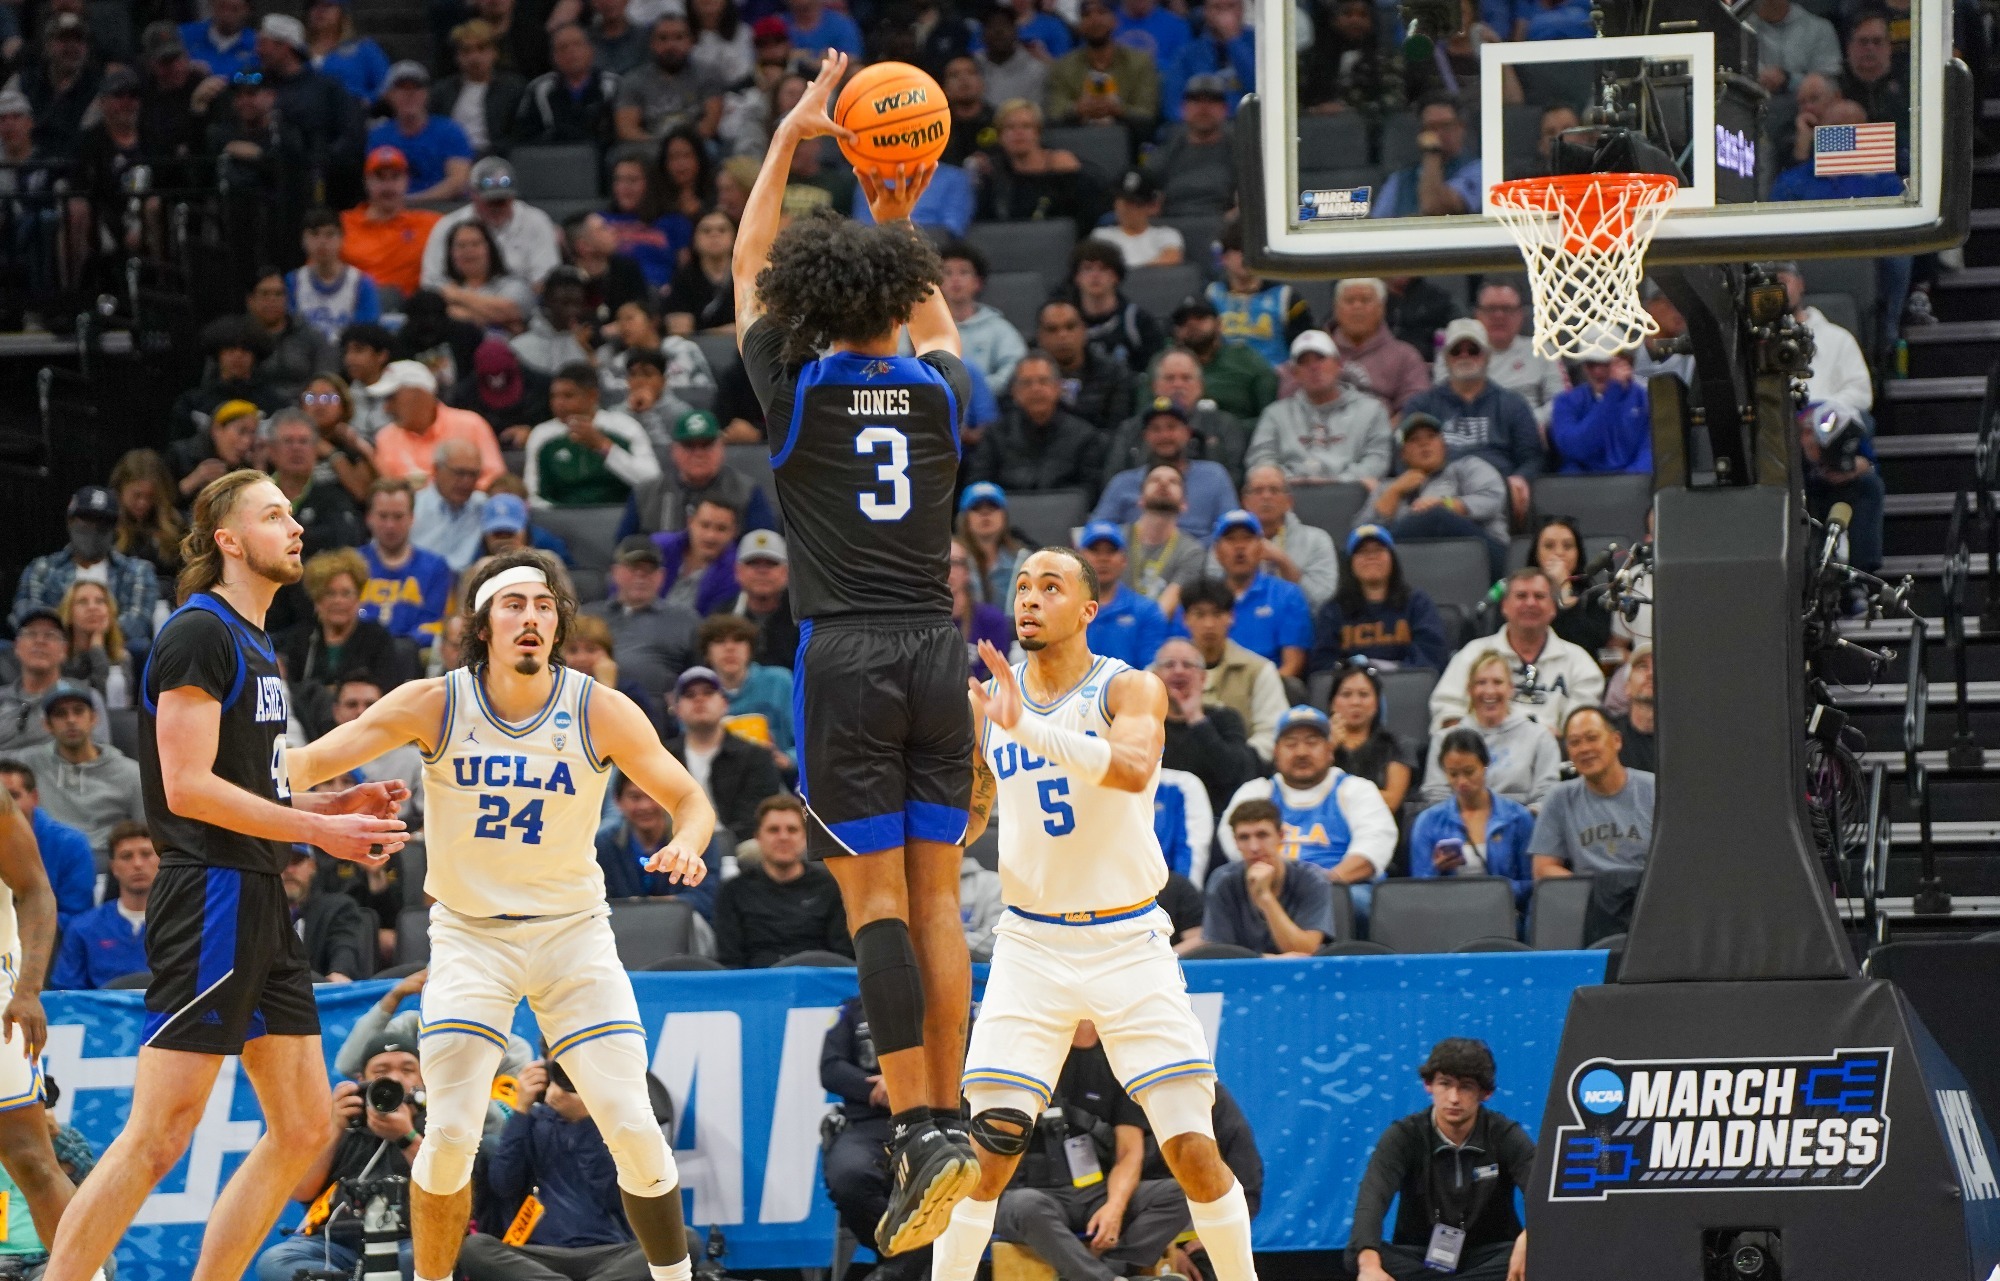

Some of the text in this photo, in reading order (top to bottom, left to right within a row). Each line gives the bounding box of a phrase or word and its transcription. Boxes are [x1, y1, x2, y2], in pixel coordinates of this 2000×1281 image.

[872, 87, 927, 115] NCAA
[872, 119, 945, 148] Wilson
[848, 389, 910, 415] JONES
[855, 426, 911, 521] 3
[453, 755, 576, 796] UCLA
[474, 793, 544, 845] 24
[1037, 777, 1076, 837] 5
[1580, 823, 1643, 847] UCLA
[1583, 1090, 1624, 1104] NCAA
[1626, 1068, 1797, 1119] MARCH
[1649, 1117, 1880, 1169] MADNESS
